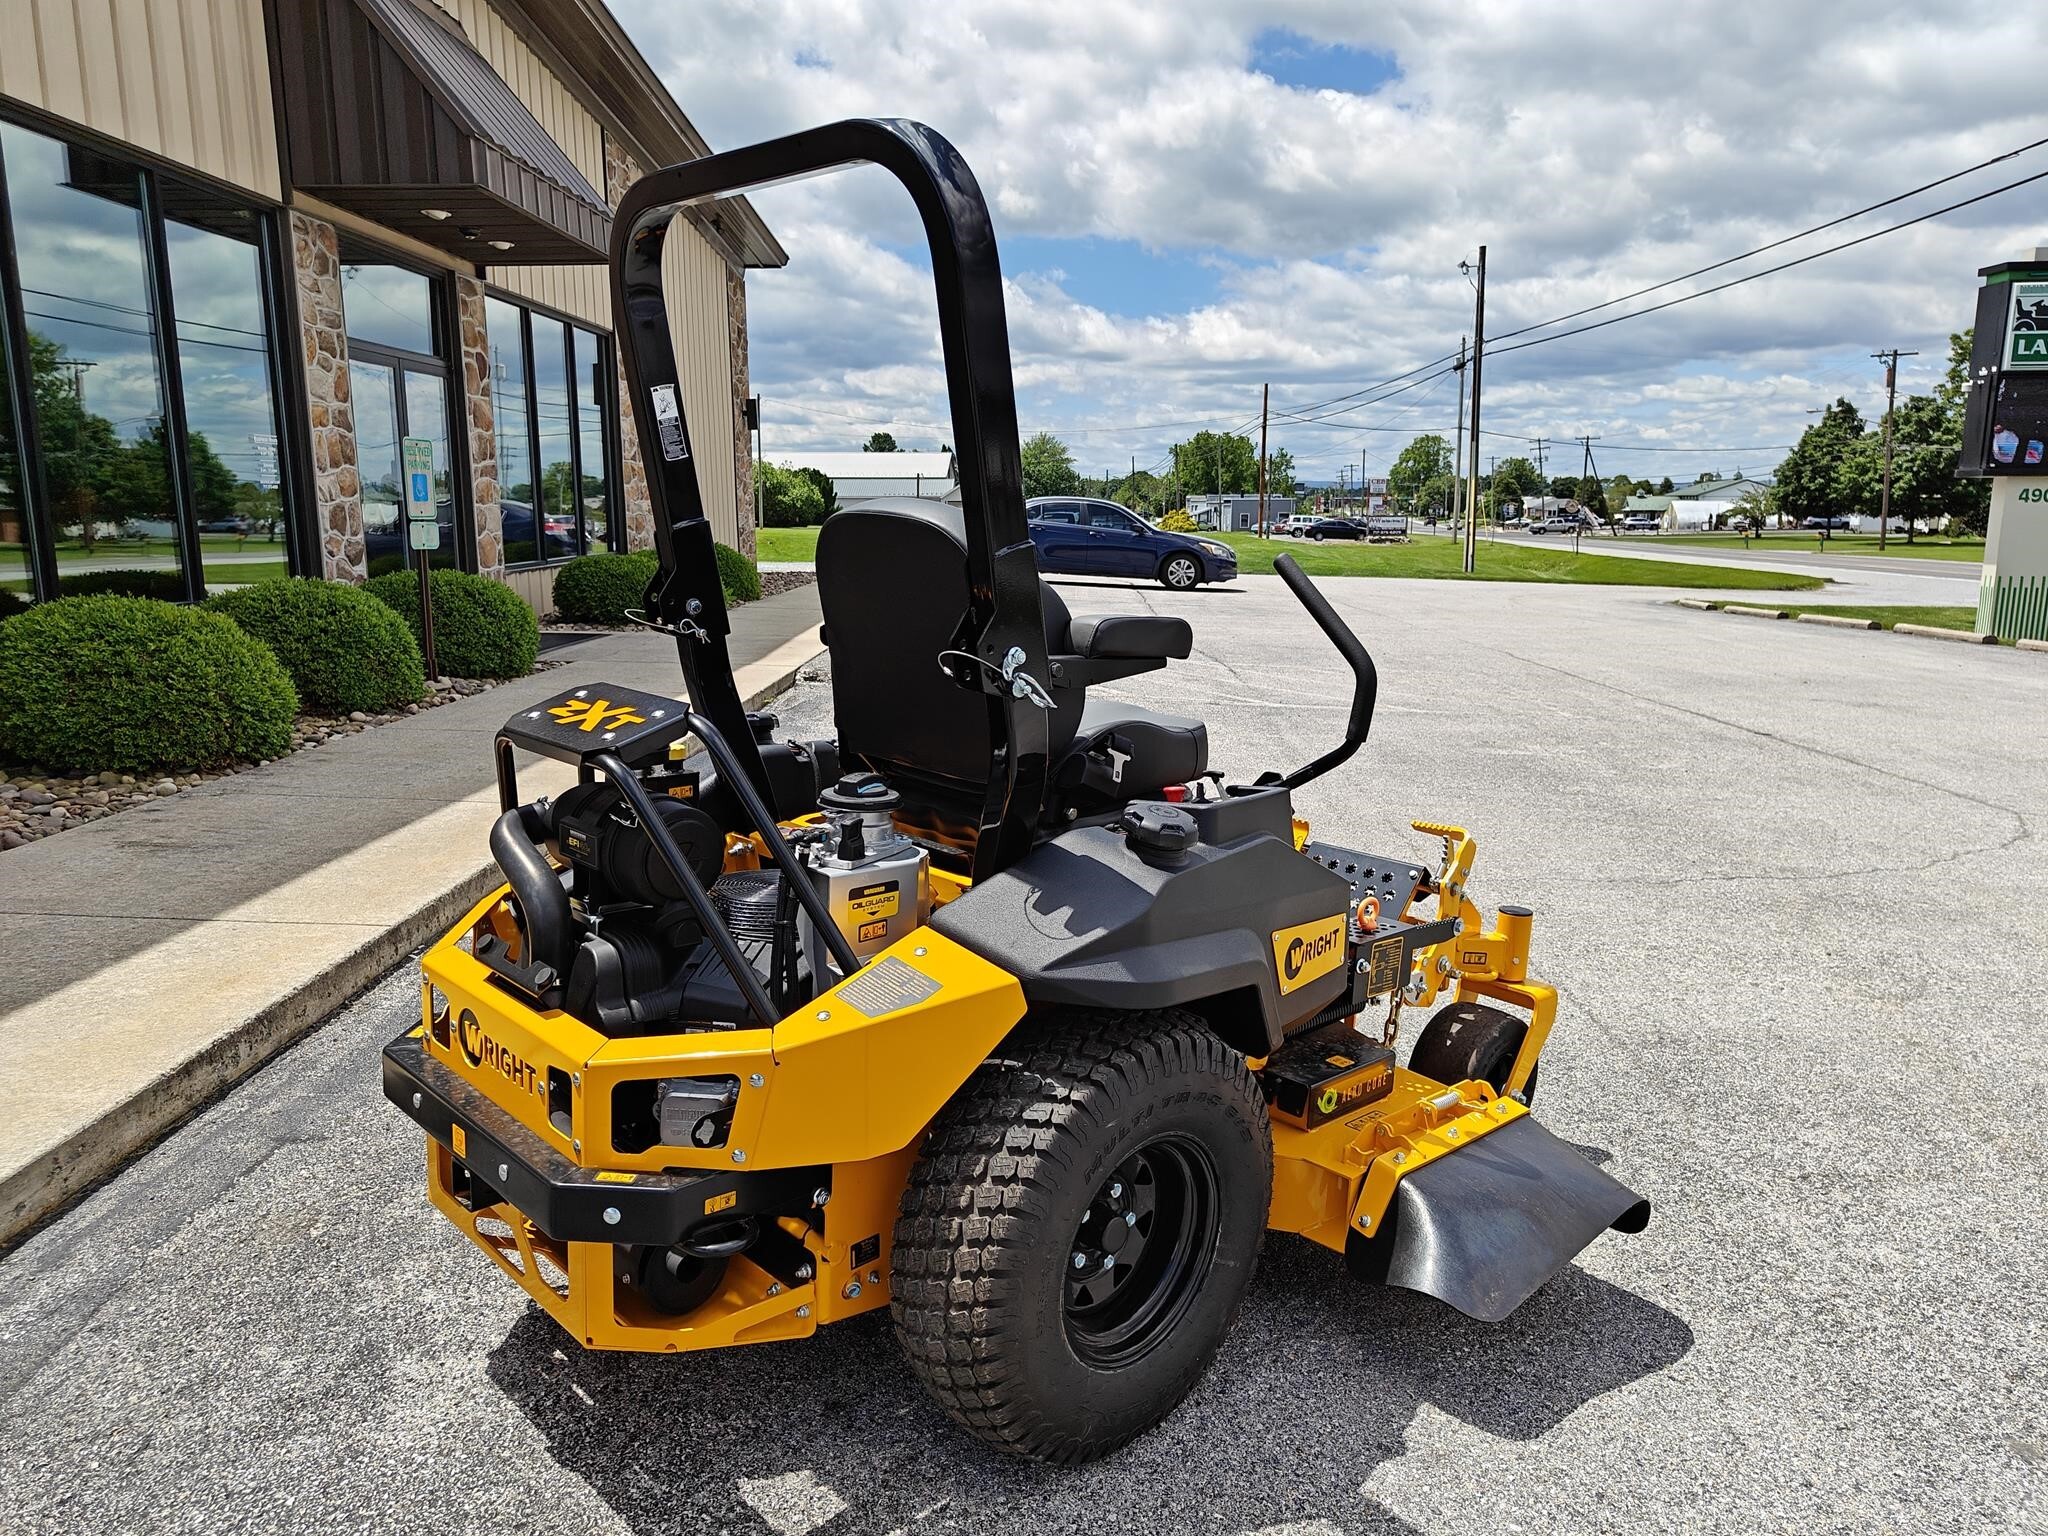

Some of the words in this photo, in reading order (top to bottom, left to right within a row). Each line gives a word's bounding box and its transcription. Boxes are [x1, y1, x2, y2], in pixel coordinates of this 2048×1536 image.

[2017, 338, 2048, 355] LA
[408, 460, 430, 471] PARKING
[546, 699, 646, 732] ZXT
[852, 895, 895, 910] OILGUARD
[1285, 927, 1340, 980] WRIGHT
[458, 1008, 537, 1096] WRIGHT
[1366, 1072, 1387, 1093] CORE
